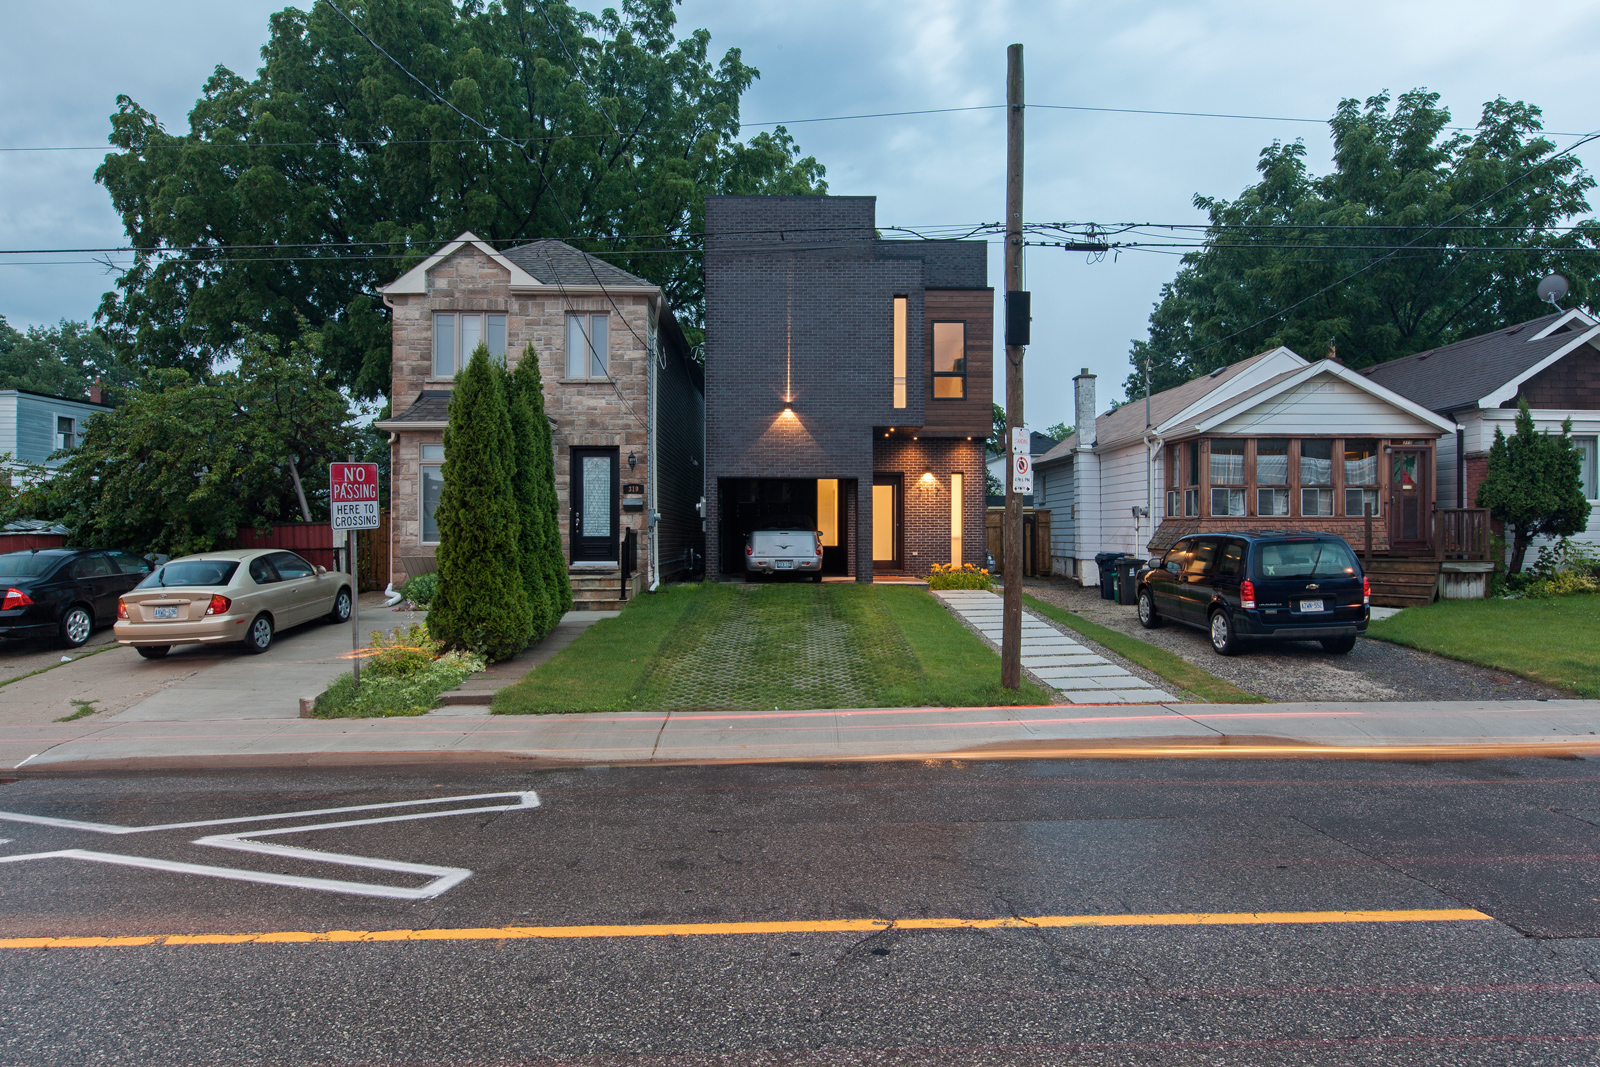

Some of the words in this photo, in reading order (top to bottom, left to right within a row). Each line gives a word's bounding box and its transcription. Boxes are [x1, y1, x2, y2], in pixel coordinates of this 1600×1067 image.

[344, 467, 365, 482] NO
[334, 484, 376, 499] PASSING
[337, 504, 360, 515] HERE
[364, 504, 374, 514] TO
[335, 515, 377, 527] CROSSING
